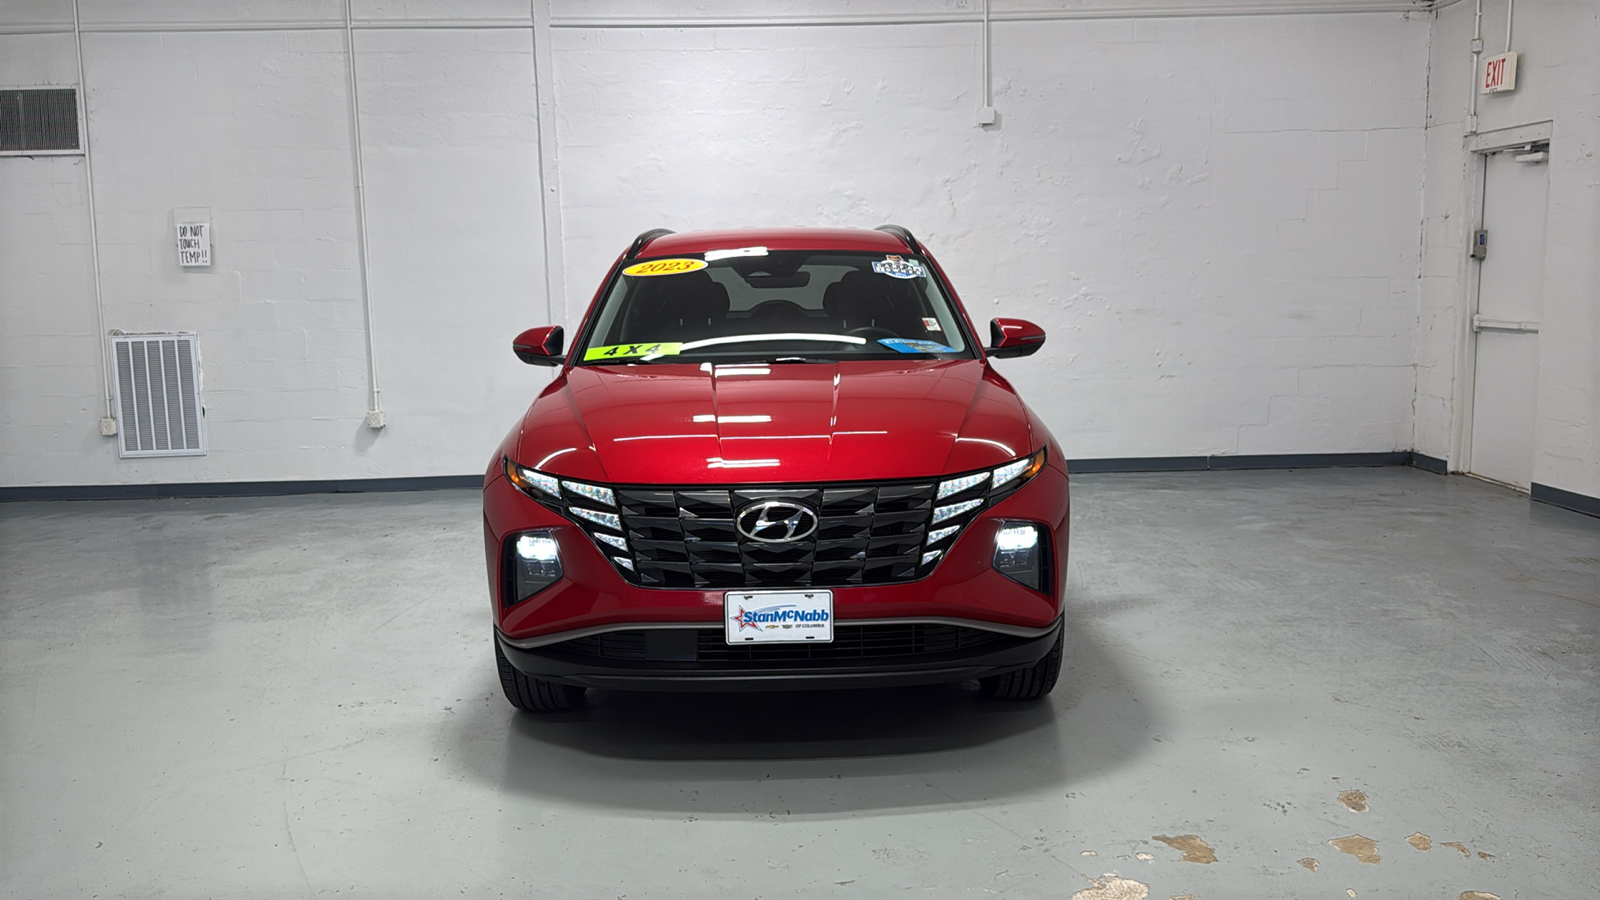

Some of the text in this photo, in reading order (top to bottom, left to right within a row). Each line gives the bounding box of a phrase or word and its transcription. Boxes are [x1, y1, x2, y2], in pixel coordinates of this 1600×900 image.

[1485, 58, 1506, 88] EXIT
[179, 225, 204, 238] DO NOT
[179, 238, 200, 250] TOUCH
[635, 261, 695, 274] 2023
